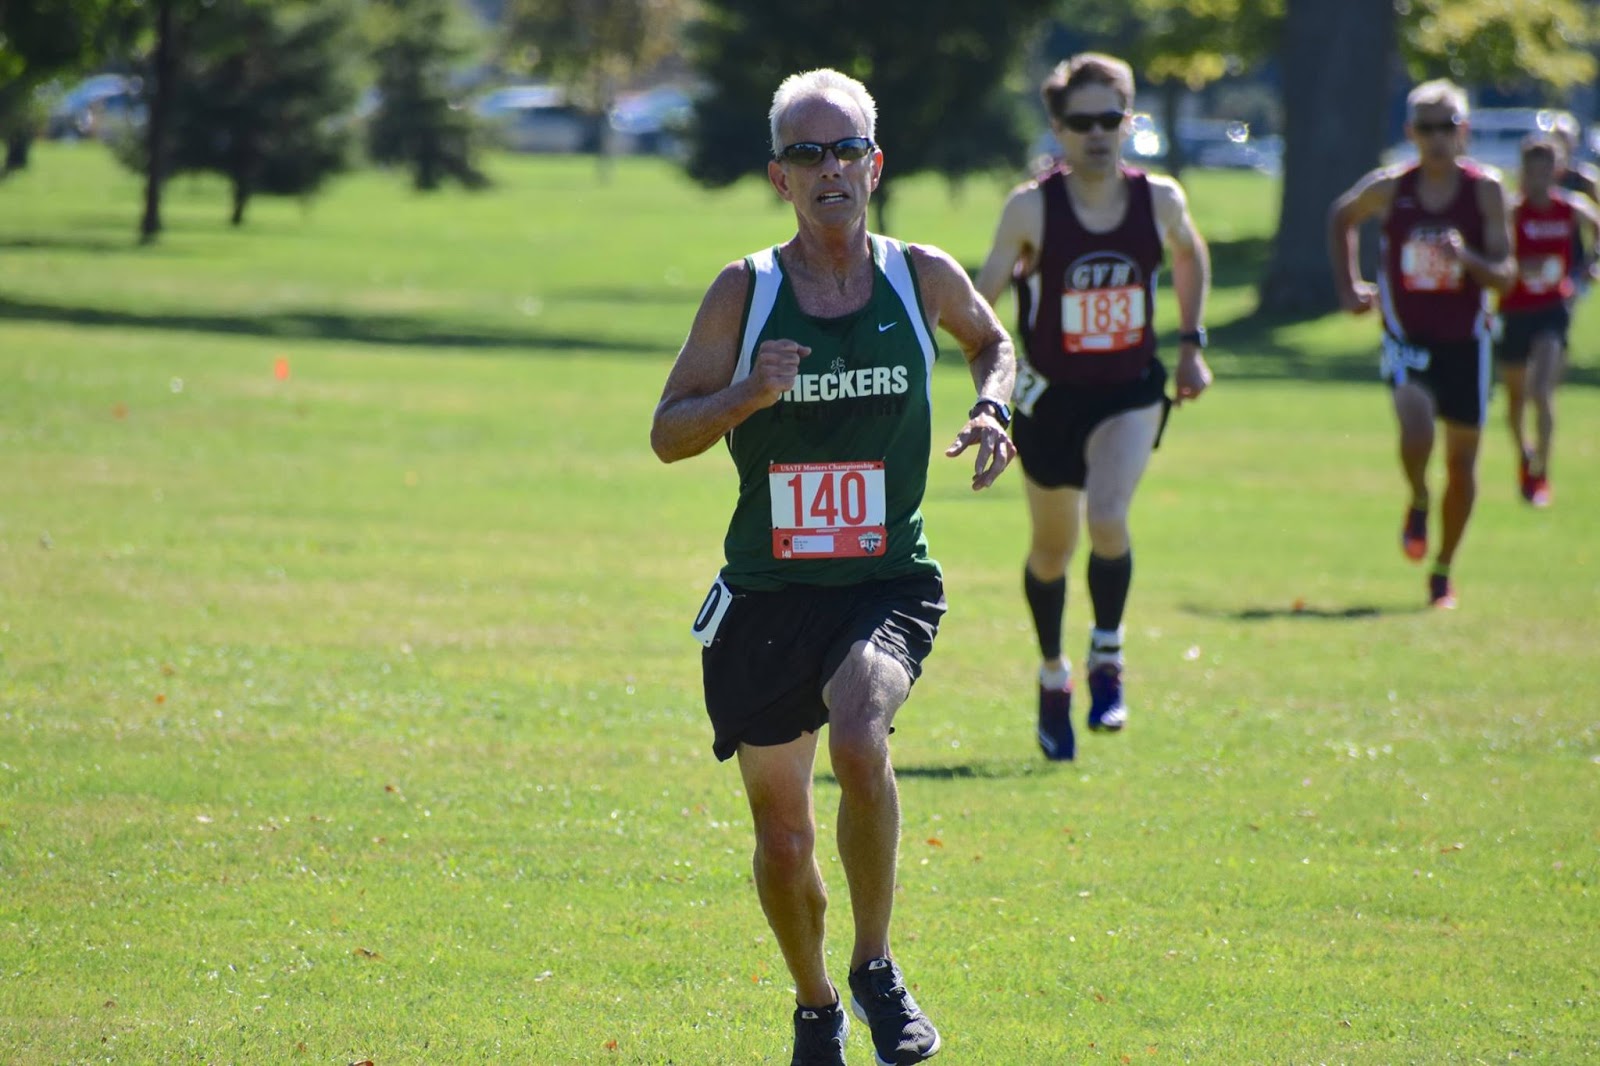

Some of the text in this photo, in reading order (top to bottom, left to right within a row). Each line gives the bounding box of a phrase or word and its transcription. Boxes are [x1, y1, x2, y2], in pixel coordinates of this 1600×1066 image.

[1079, 293, 1132, 334] 183
[778, 365, 909, 402] HECKERS
[780, 461, 874, 472] USATF Masters Championship
[787, 471, 867, 527] 140
[693, 582, 722, 632] 0
